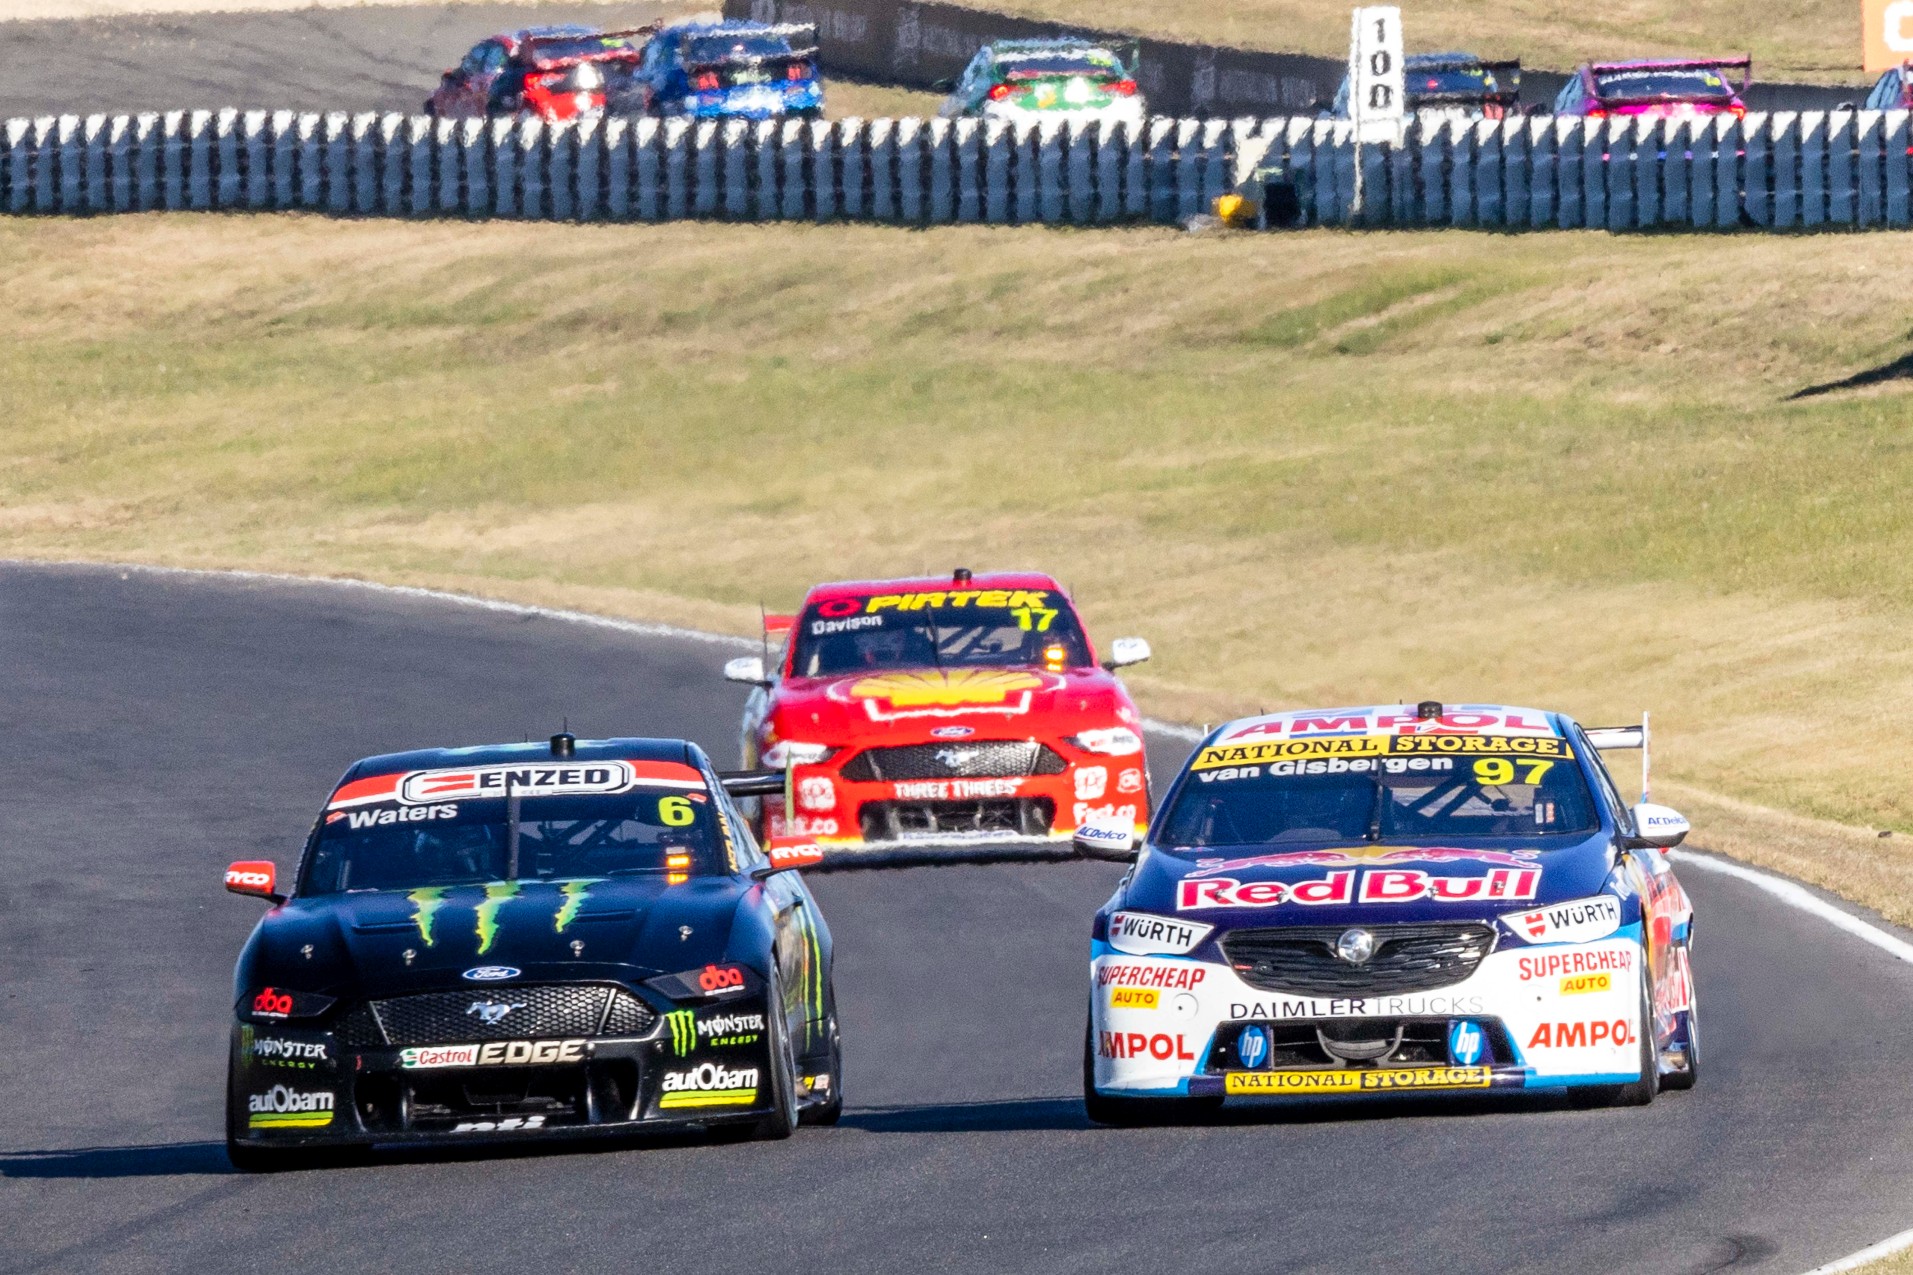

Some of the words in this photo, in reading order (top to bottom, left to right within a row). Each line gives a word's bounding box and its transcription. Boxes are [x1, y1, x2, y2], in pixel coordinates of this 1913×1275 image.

[1369, 17, 1394, 110] 100
[865, 590, 1049, 613] PIRTEK
[812, 615, 882, 635] Davison
[1010, 607, 1059, 632] 17
[1225, 712, 1550, 741] AMPOL
[1204, 738, 1379, 764] NATIONAL
[1396, 735, 1560, 754] STORAGE
[480, 769, 610, 788] ENZED
[1199, 766, 1260, 783] van
[1268, 756, 1454, 777] Gisbergen
[1472, 758, 1555, 786] 97
[350, 804, 458, 829] Waters
[658, 795, 695, 827] 6
[1076, 826, 1127, 841] ACDelco
[771, 844, 823, 860] RYCO
[1176, 869, 1356, 911] Red
[1359, 867, 1543, 903] Bull
[700, 963, 744, 990] dba
[1098, 965, 1206, 991] SUPERCHEAP
[1518, 950, 1632, 981] SUPERCHEAP
[1564, 976, 1608, 991] AUTO
[254, 987, 293, 1013] dba
[1113, 991, 1155, 1005] AUTO
[1230, 1000, 1366, 1019] DAIMLER
[1373, 995, 1485, 1016] TRUCKS
[1099, 1031, 1194, 1061] AMPOL
[1456, 1021, 1481, 1066] hp
[1527, 1019, 1636, 1049] AMPOL
[419, 1048, 473, 1066] Castrol
[477, 1039, 587, 1065] EDGE
[1241, 1032, 1263, 1068] hp
[1231, 1073, 1353, 1090] NATIONAL
[1365, 1067, 1479, 1089] STORAGE
